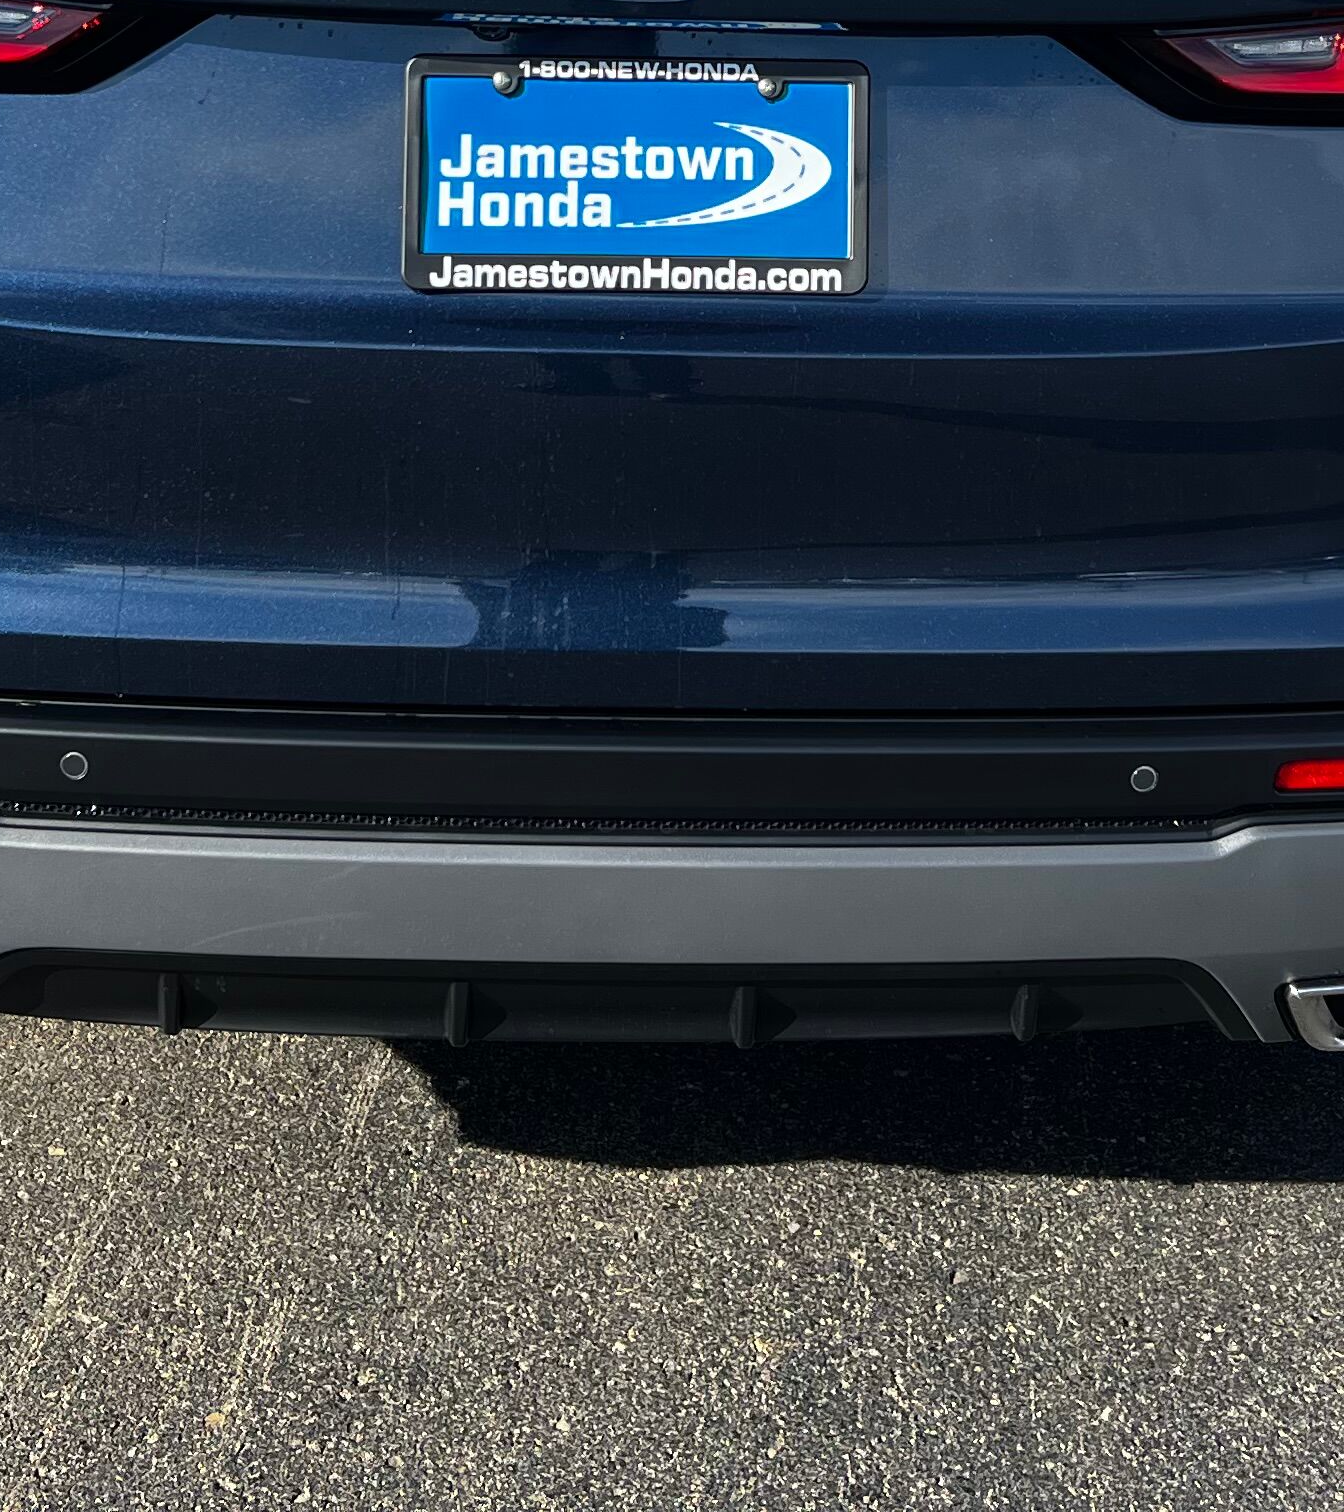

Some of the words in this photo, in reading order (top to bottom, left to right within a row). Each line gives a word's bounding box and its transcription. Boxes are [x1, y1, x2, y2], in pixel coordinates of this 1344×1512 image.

[518, 59, 760, 82] 1-800-NEW-HONDA
[440, 133, 754, 181] Jamestown
[438, 181, 612, 228] Honda
[428, 256, 843, 292] JamestownHonda.com
